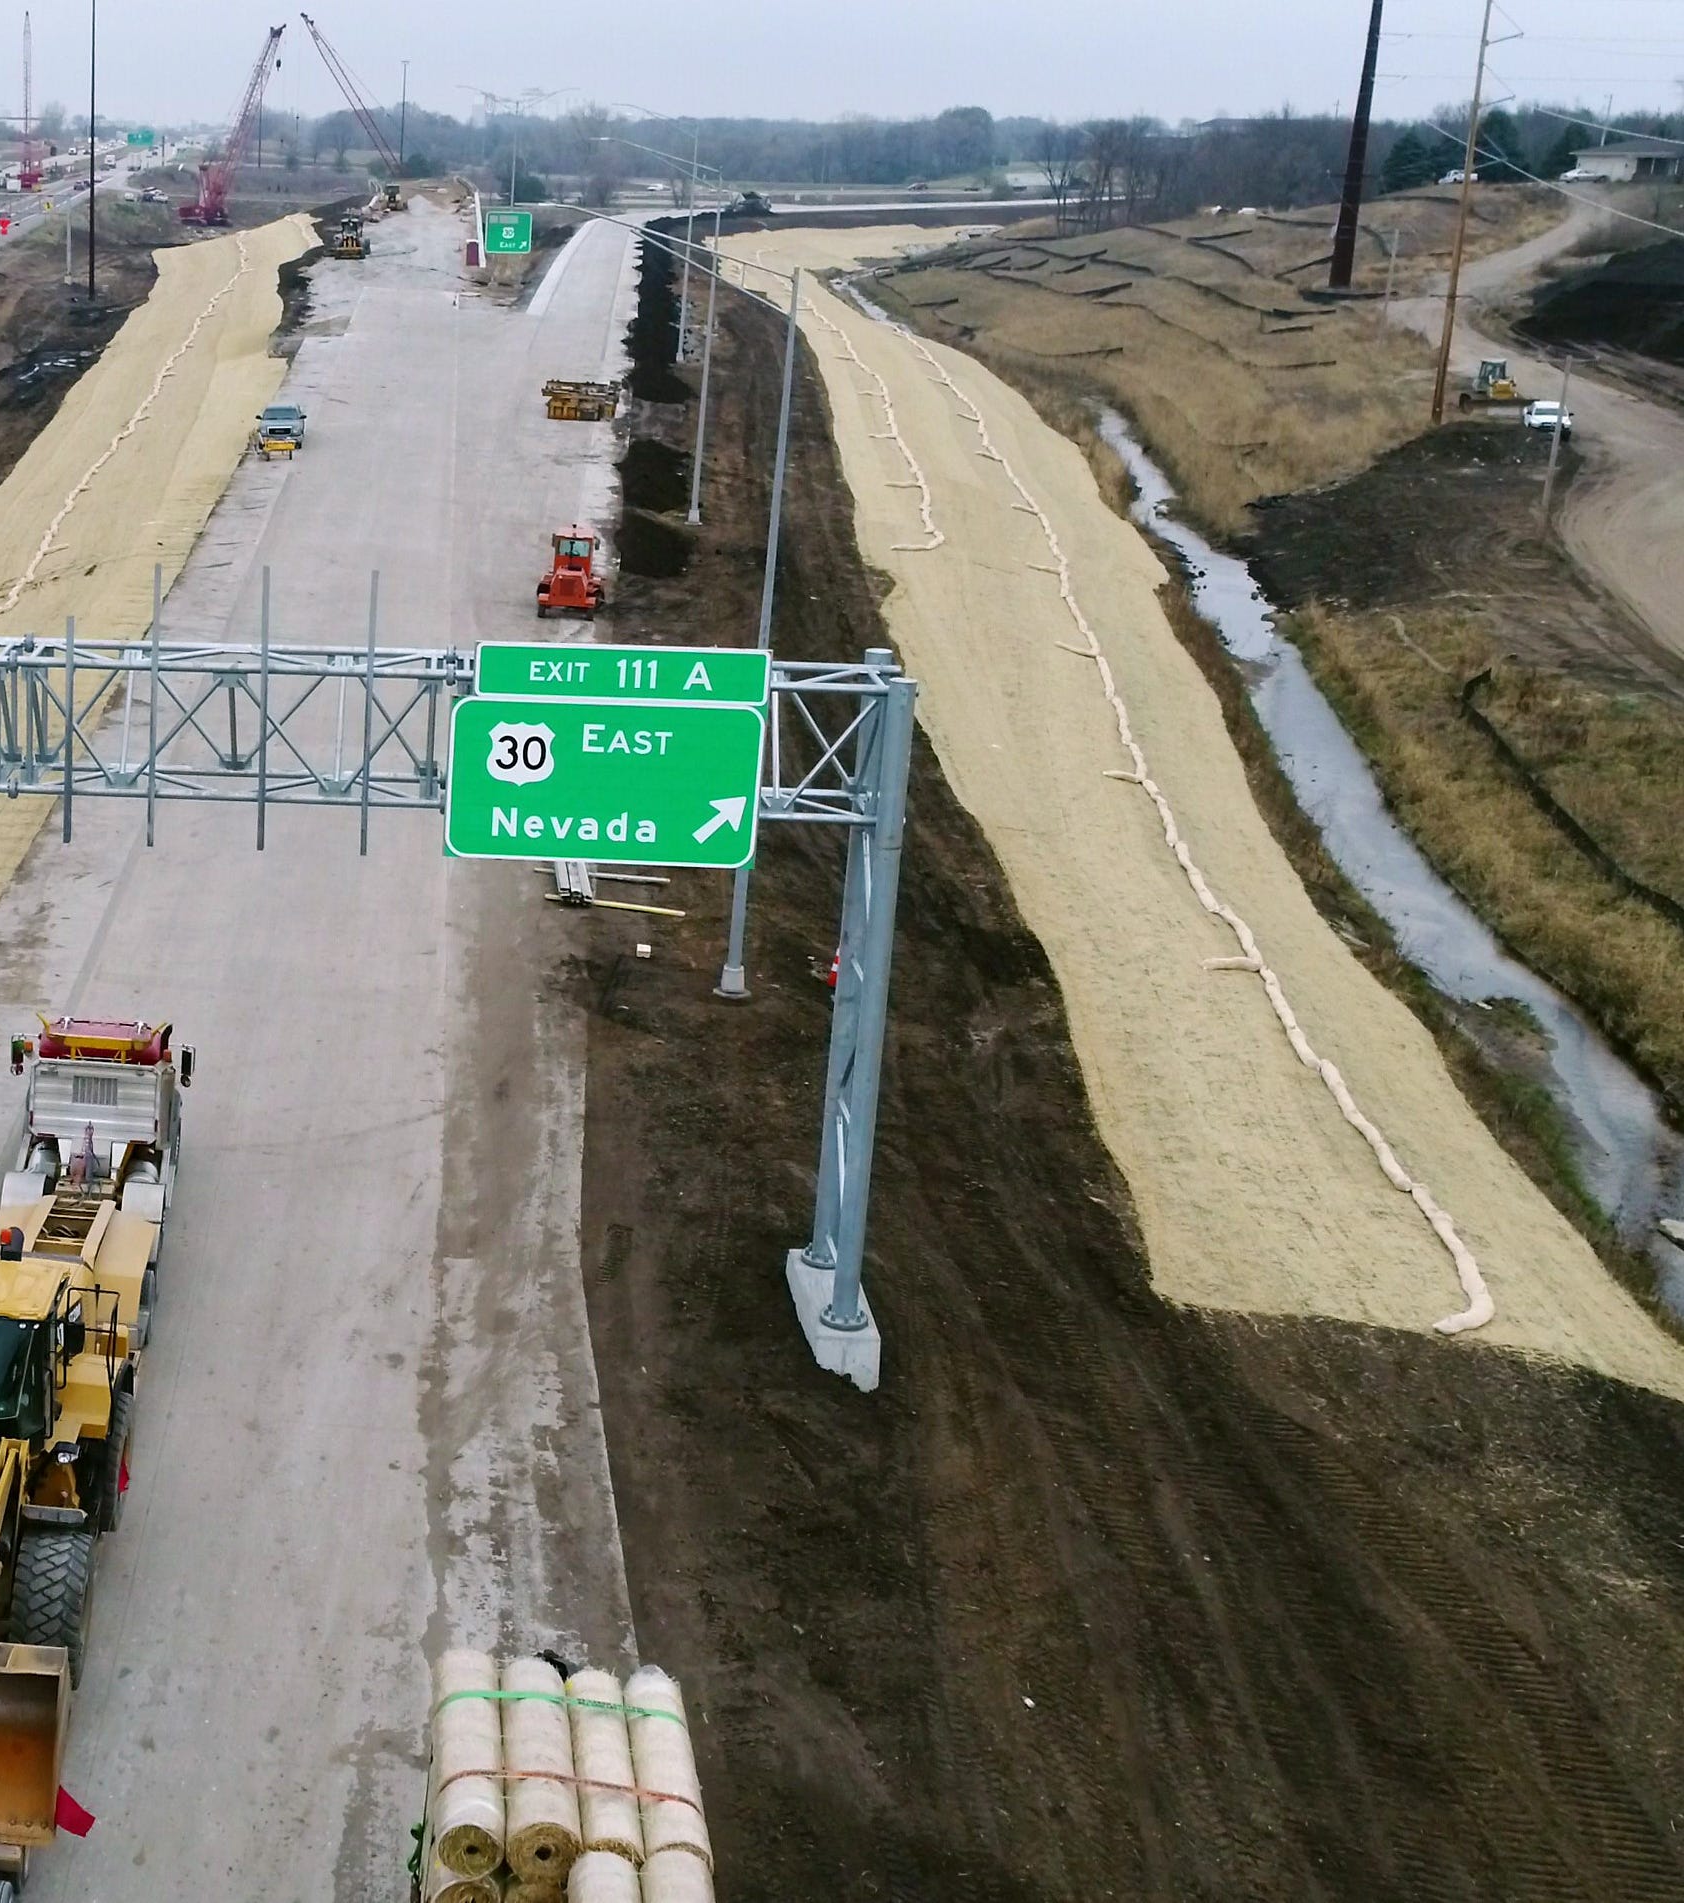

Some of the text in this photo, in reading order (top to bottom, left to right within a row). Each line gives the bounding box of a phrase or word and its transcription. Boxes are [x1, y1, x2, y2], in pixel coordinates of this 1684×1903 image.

[529, 659, 713, 691] EXIT 111 A
[495, 735, 547, 771] 30
[581, 723, 674, 756] EAST
[491, 806, 657, 844] Nevada
